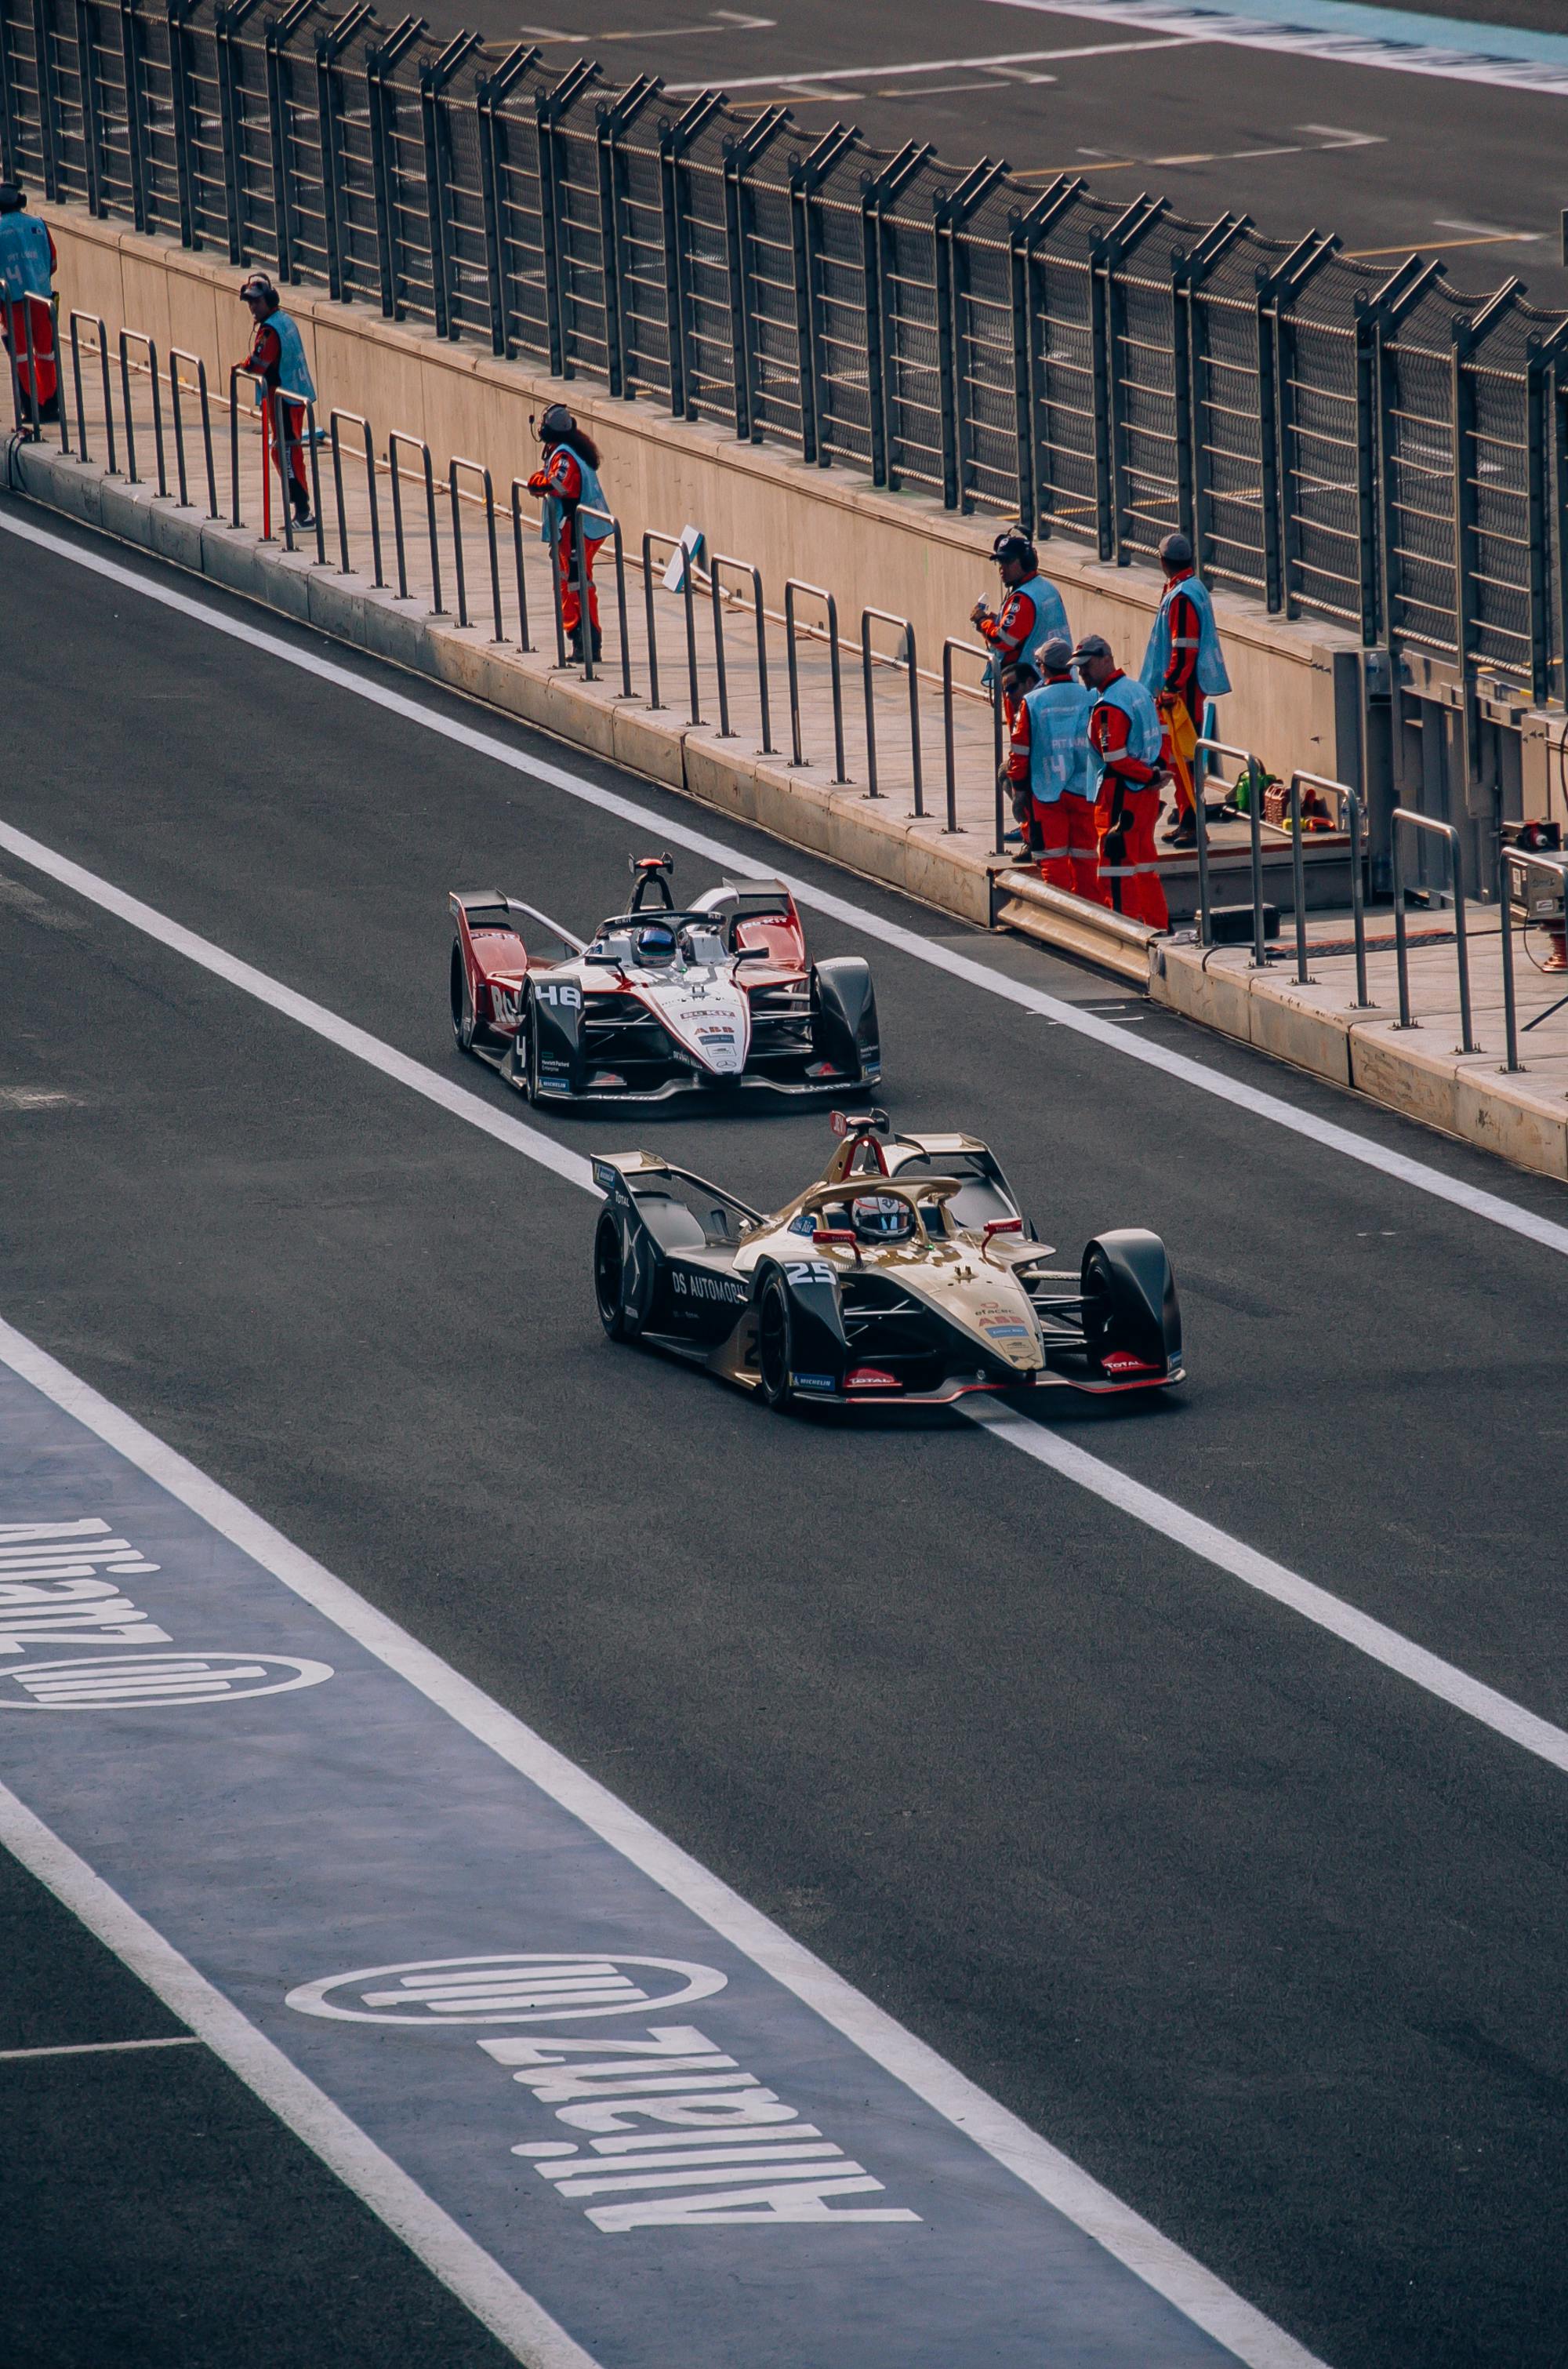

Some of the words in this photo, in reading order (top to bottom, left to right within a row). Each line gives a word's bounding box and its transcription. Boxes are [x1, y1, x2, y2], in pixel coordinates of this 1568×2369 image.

[1051, 754, 1066, 782] 4
[535, 985, 581, 1010] 48
[694, 1026, 735, 1035] ABB
[672, 1271, 688, 1295] DS
[784, 1262, 837, 1286] 25
[978, 1316, 1025, 1328] ABB
[1105, 1361, 1145, 1369] TOTAL
[800, 1377, 832, 1386] MICHELIN
[476, 2025, 924, 2233] Allianz
